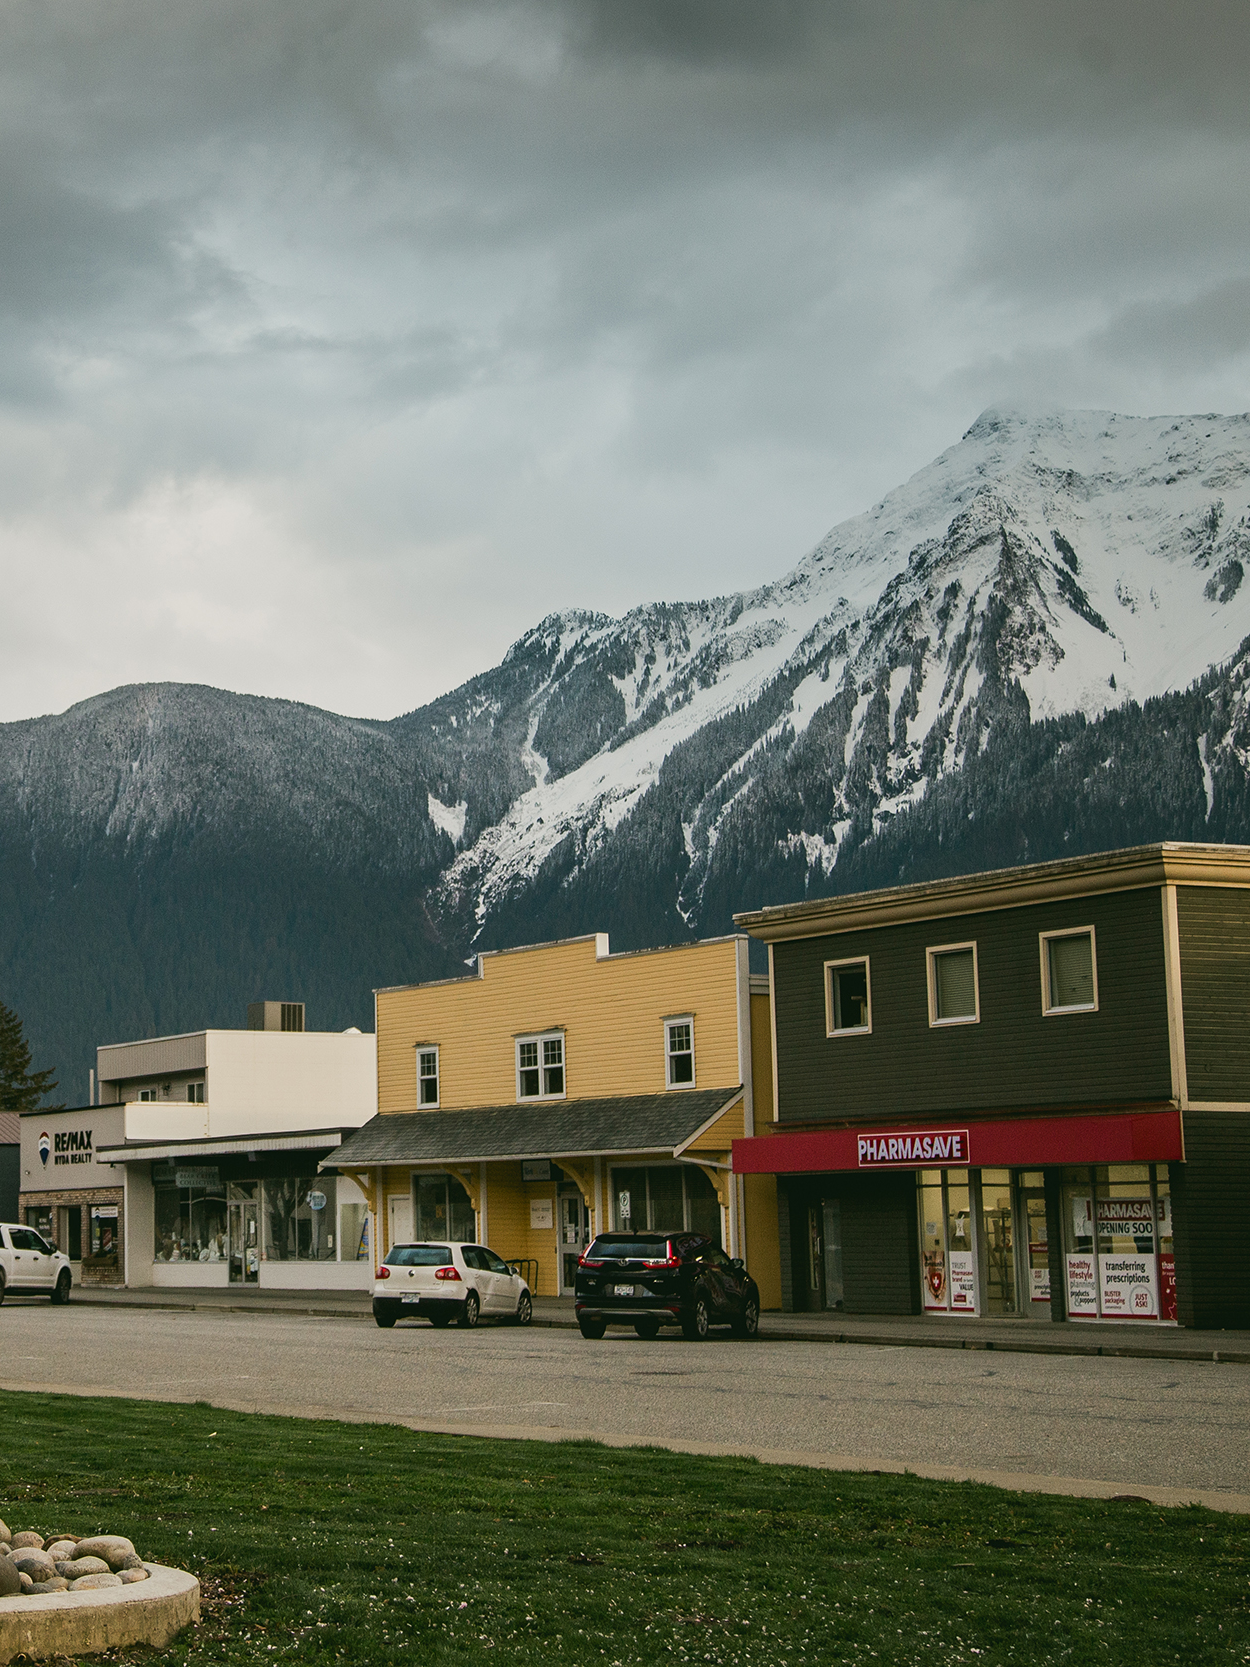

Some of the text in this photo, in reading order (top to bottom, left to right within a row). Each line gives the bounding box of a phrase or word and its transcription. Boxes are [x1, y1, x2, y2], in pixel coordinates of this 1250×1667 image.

[54, 1130, 93, 1152] RE/MAX
[858, 1135, 961, 1161] PHARMASAVE
[70, 1153, 92, 1164] REALTY
[1098, 1203, 1163, 1219] HARMASAVE
[1132, 1222, 1153, 1234] SOO
[1068, 1260, 1091, 1275] healthy
[1105, 1260, 1146, 1274] transferring
[1069, 1270, 1093, 1281] lifestyle
[1106, 1273, 1150, 1286] prescriptions
[958, 1283, 974, 1292] VALUE
[1135, 1293, 1148, 1301] JUST
